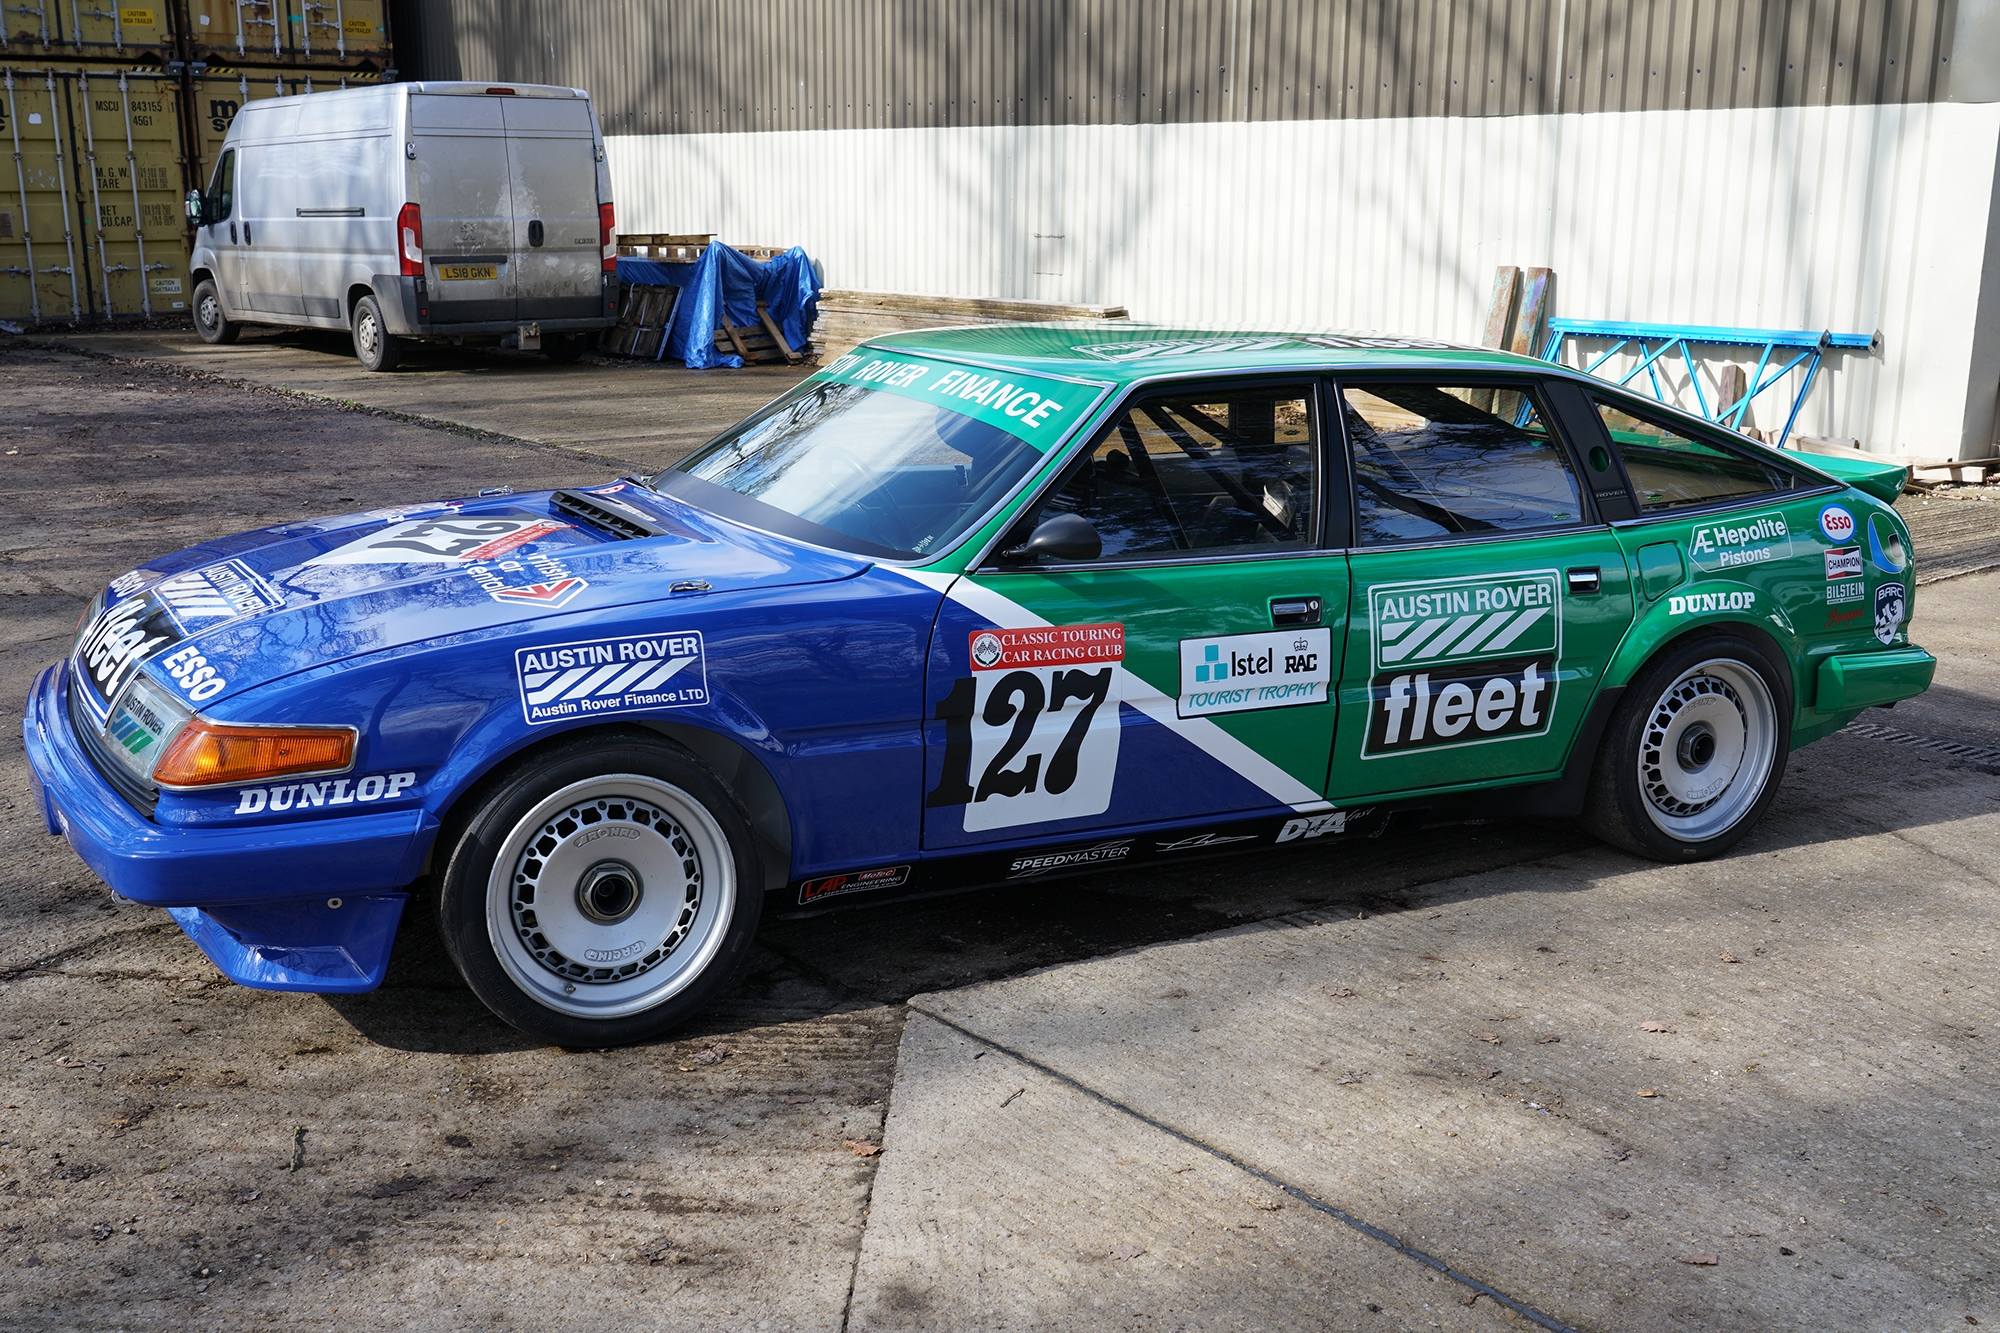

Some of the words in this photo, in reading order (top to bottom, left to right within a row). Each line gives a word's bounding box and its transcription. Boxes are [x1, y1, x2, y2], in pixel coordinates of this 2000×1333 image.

[95, 101, 119, 112] MSCU
[131, 101, 162, 112] 843155
[133, 116, 152, 126] 45G1
[97, 179, 119, 188] TARE
[101, 206, 116, 215] NET
[445, 267, 470, 279] LS18
[471, 266, 491, 277] GKN
[850, 360, 930, 388] ROVER
[927, 371, 1064, 429] FINANCE
[1713, 519, 1787, 547] Hepolite
[1719, 546, 1771, 567] Pistons
[1828, 557, 1861, 570] CHAMPION
[110, 570, 146, 598] ESSO
[202, 566, 238, 594] AUSTIN
[226, 580, 267, 616] ROVER
[1826, 582, 1865, 599] BILSTEIN
[1878, 587, 1903, 601] BARC
[1381, 589, 1471, 621] AUSTIN
[1475, 583, 1552, 611] ROVER
[1669, 590, 1756, 616] DUNLOP
[83, 598, 170, 697] fleet
[1001, 631, 1058, 647] CLASSIC
[1061, 627, 1122, 643] TOURING
[523, 644, 615, 673] AUSTIN
[618, 636, 699, 662] ROVER
[1002, 650, 1031, 664] CAR
[1033, 647, 1085, 662] RACING
[1087, 644, 1123, 658] CLUB
[1284, 653, 1317, 674] RAC
[162, 645, 226, 701] ESSO
[531, 700, 578, 719] Austin
[581, 694, 621, 712] Rover
[624, 690, 677, 706] Finance
[680, 688, 704, 701] LTD
[1188, 687, 1255, 709] TOURIST
[1258, 681, 1321, 701] TROPHY
[1384, 661, 1546, 745] fleet
[122, 692, 145, 723] AUSTIN
[142, 711, 165, 735] ROVER
[926, 666, 1113, 809] 127
[234, 771, 416, 815] DUNLOP
[1275, 811, 1346, 843] DTA
[1010, 846, 1130, 871] SPEEDMASTER
[805, 876, 847, 898] LAP
[840, 876, 902, 890] ENGINEERING
